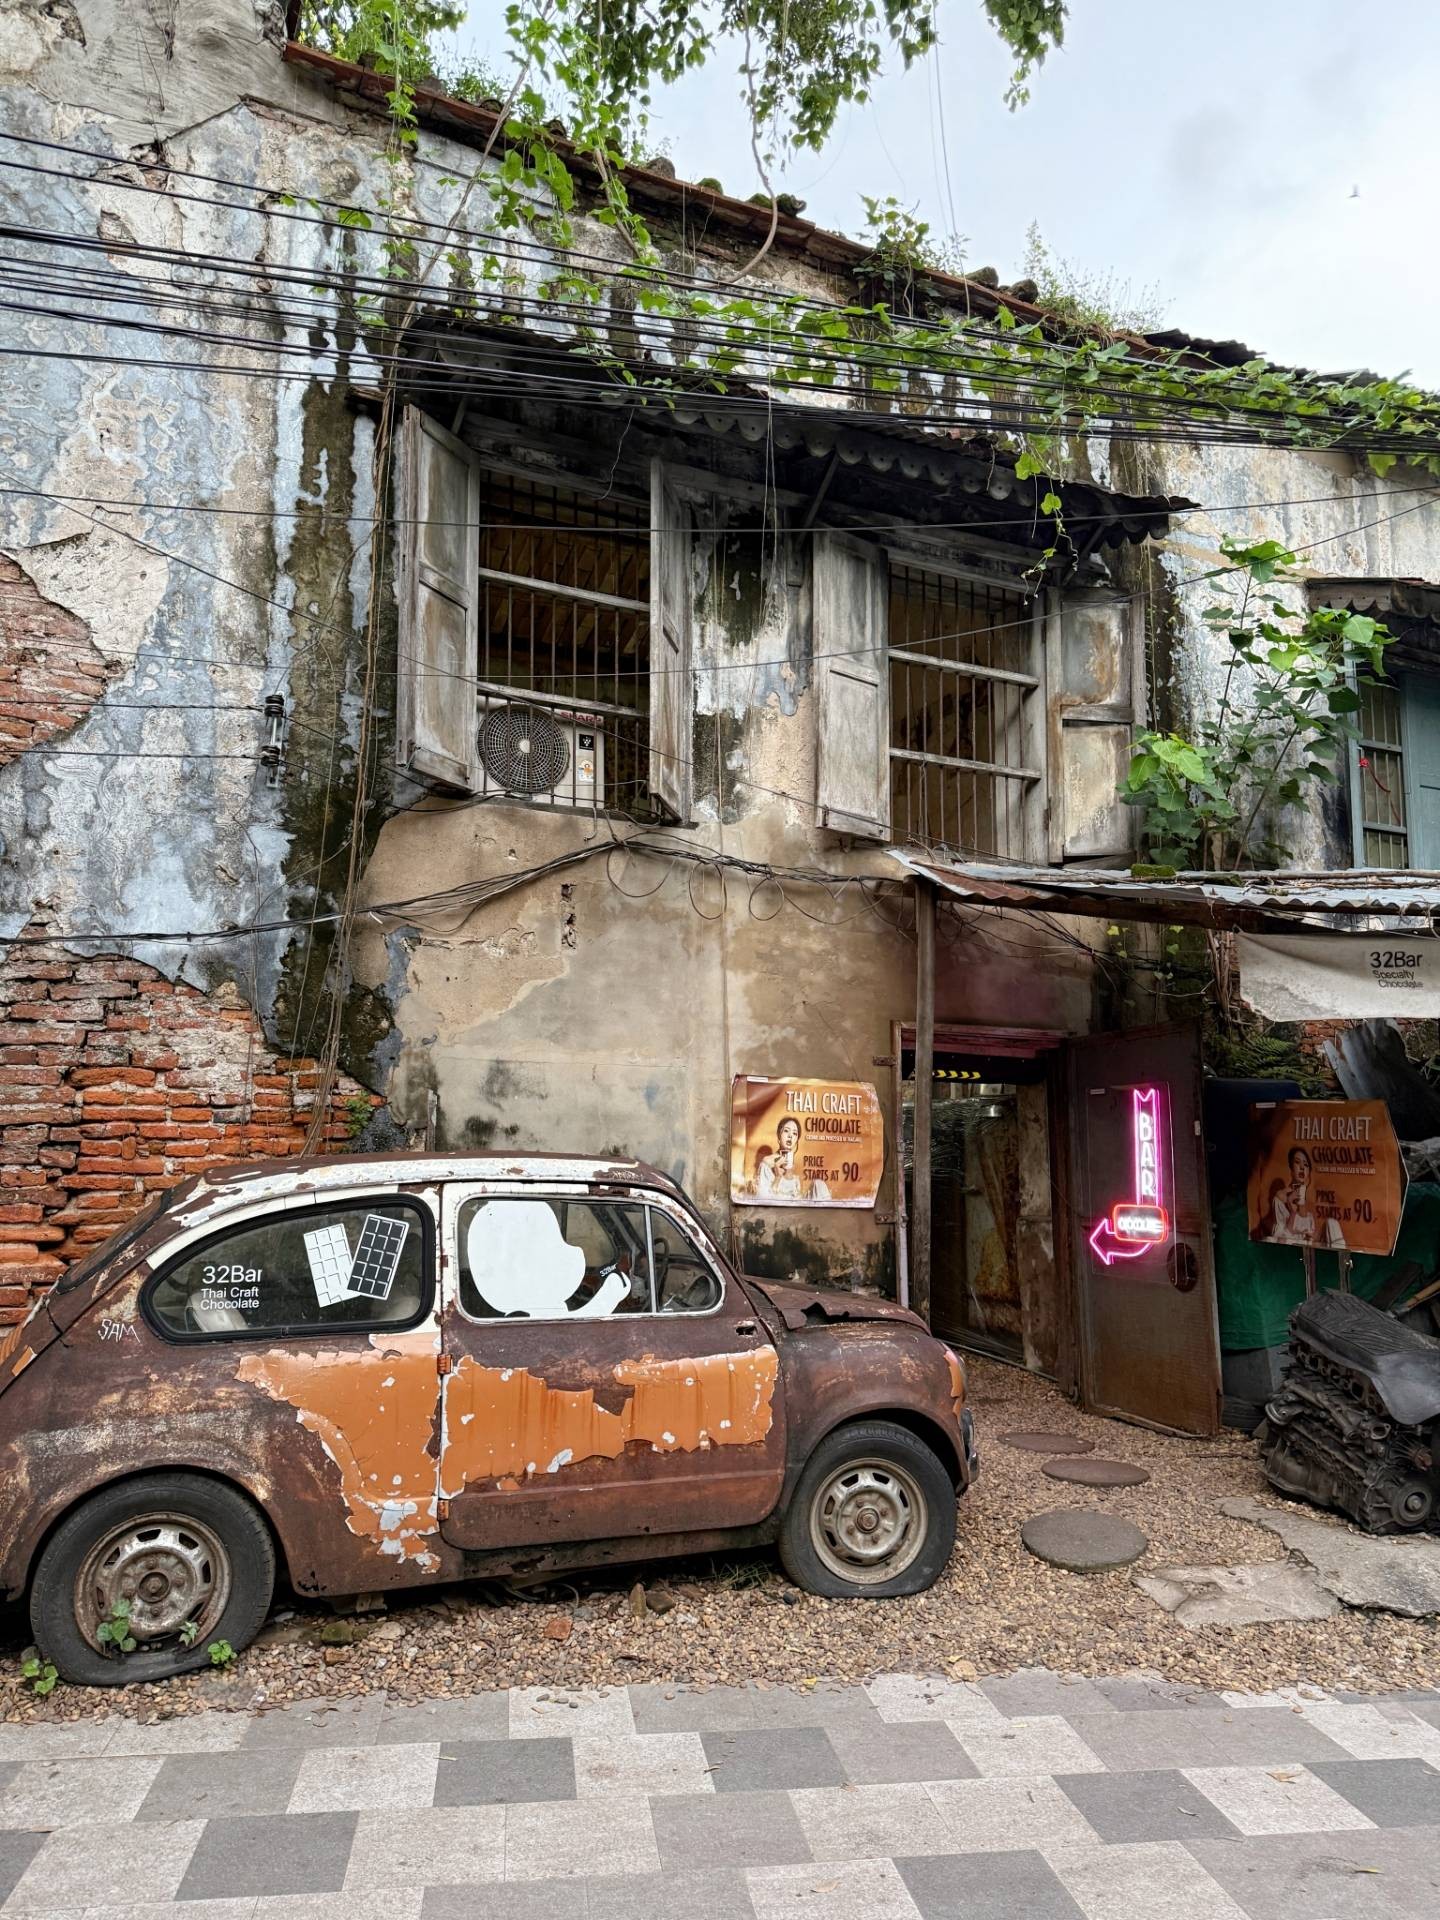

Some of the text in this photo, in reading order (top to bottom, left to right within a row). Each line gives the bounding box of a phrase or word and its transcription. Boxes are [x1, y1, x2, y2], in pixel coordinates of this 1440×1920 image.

[1369, 951, 1423, 968] 32Bar
[1372, 969, 1415, 980] Specialty
[786, 1090, 862, 1115] THAI CRAFT
[804, 1117, 862, 1134] CHOCOLATE
[1294, 1116, 1372, 1141] THAI CRAFT
[803, 1155, 824, 1168] PRICE
[1139, 1111, 1157, 1196] BAR
[1311, 1146, 1374, 1165] CHOCOLATE
[803, 1169, 829, 1182] STARTS
[830, 1171, 840, 1182] AT
[1343, 1208, 1352, 1220] AT
[202, 1265, 263, 1284] 32Bar
[201, 1287, 259, 1299] Thai Craft
[201, 1298, 260, 1311] Chocolate
[98, 1318, 141, 1344] SAM
